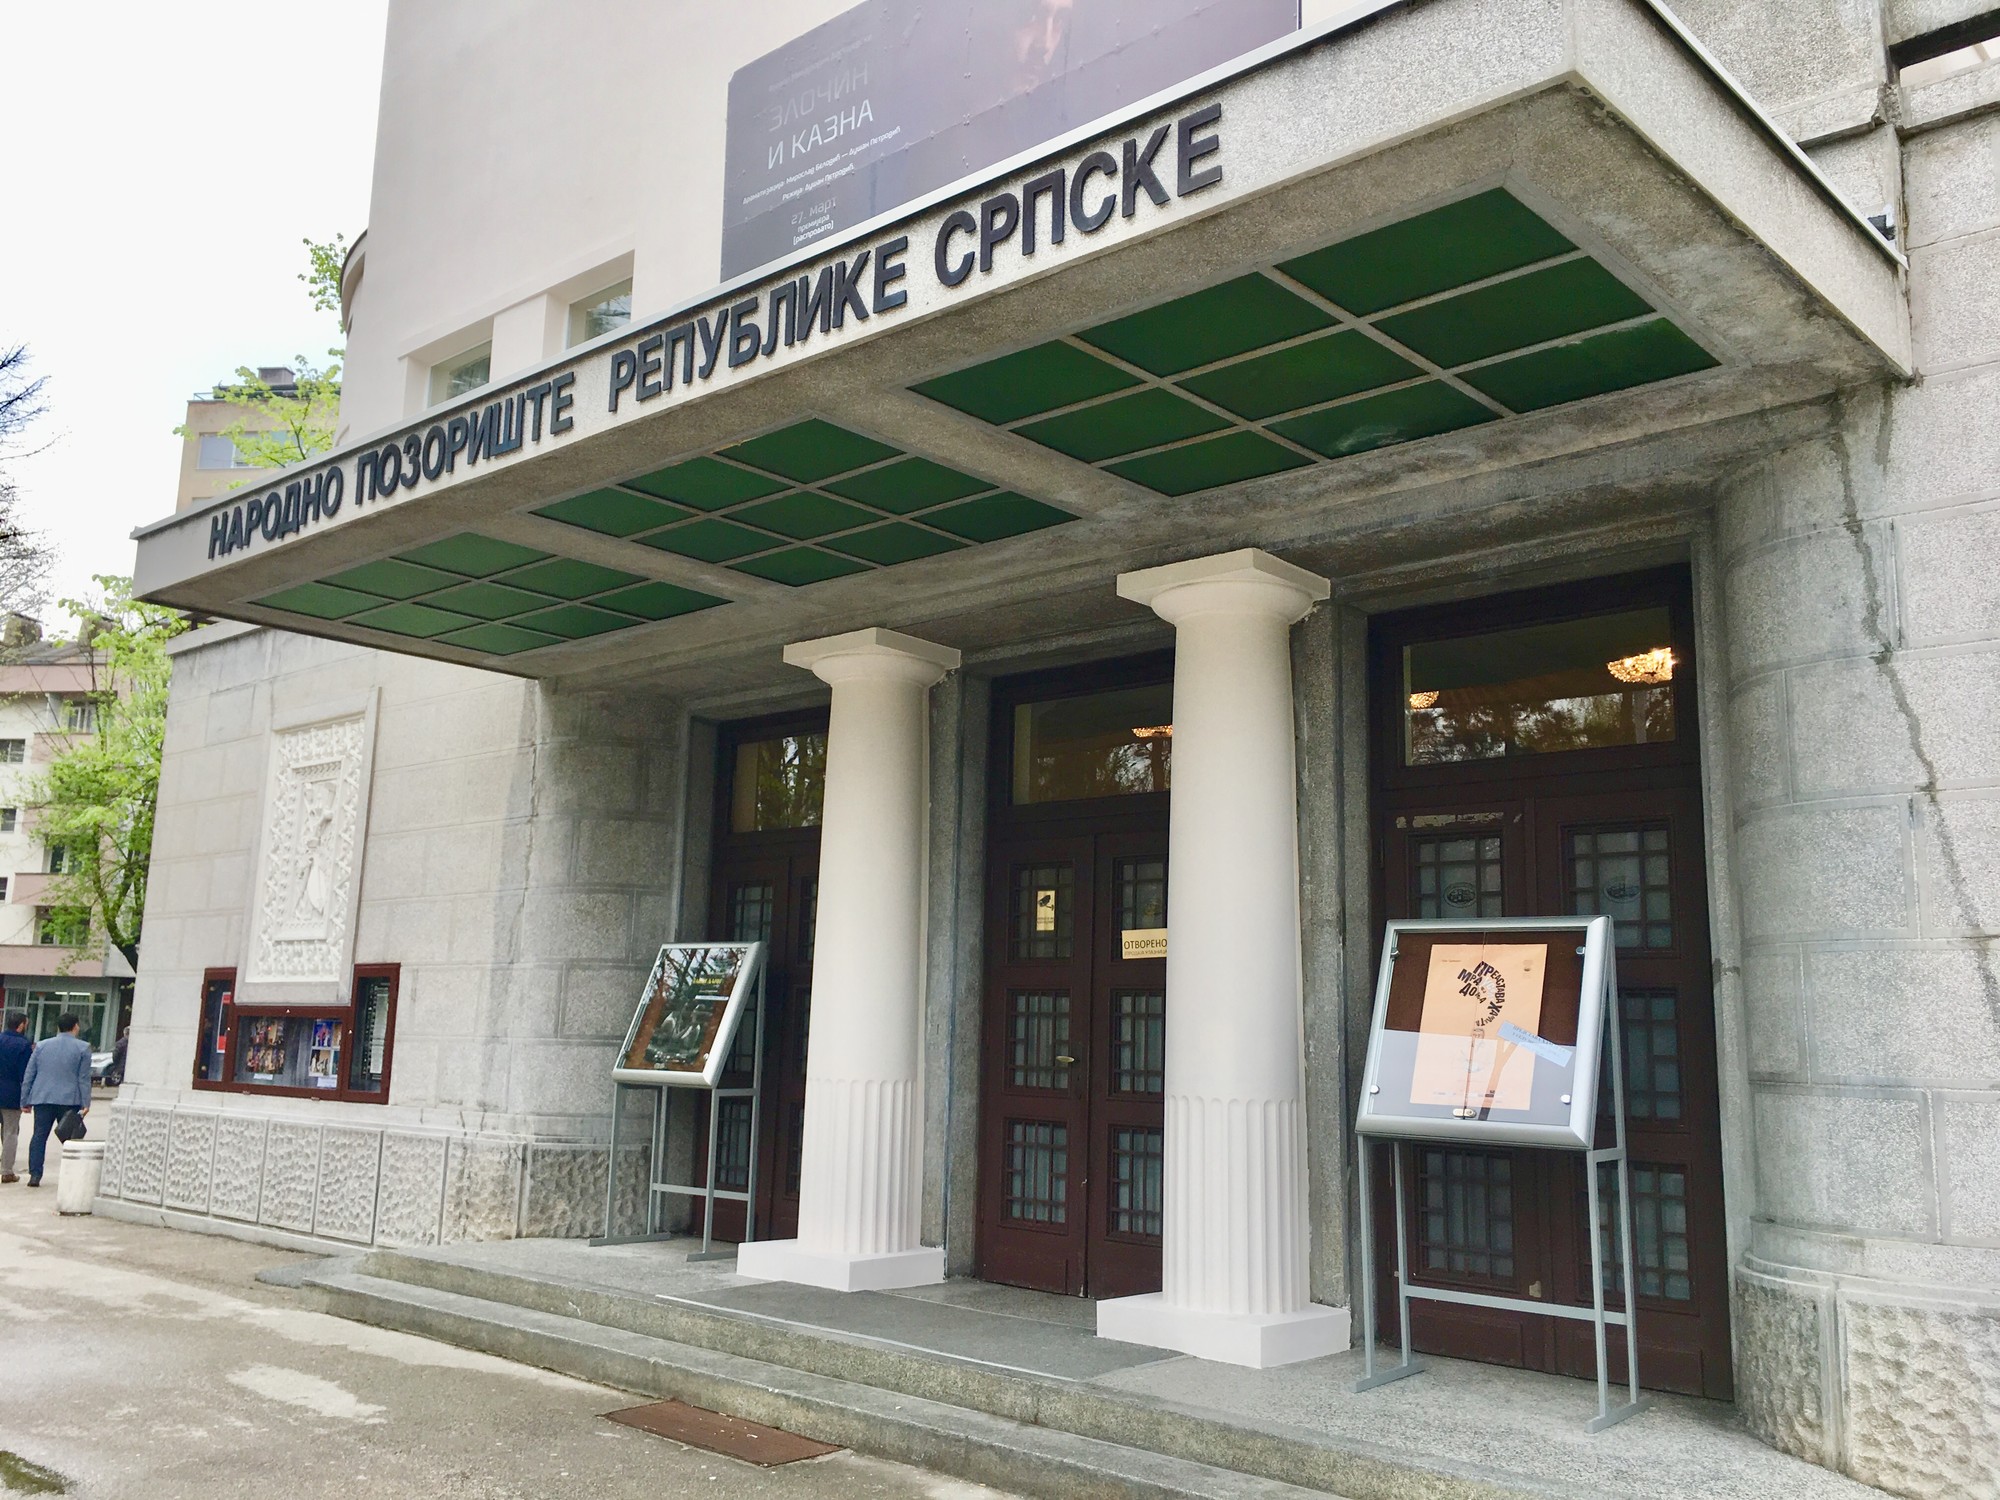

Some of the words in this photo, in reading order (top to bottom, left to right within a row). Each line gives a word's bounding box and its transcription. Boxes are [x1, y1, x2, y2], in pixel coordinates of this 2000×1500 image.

[768, 61, 869, 132] ЗЛОЧИН
[767, 140, 784, 170] И
[791, 98, 874, 159] КАЗНА
[207, 465, 344, 560] НАРОДНО
[354, 370, 576, 506] ПОЗОРИШТЕ
[608, 235, 908, 413] РЕПУБЛИКЕ
[933, 102, 1224, 288] СРПСКЕ
[1123, 939, 1167, 949] ОТВОРЕНО
